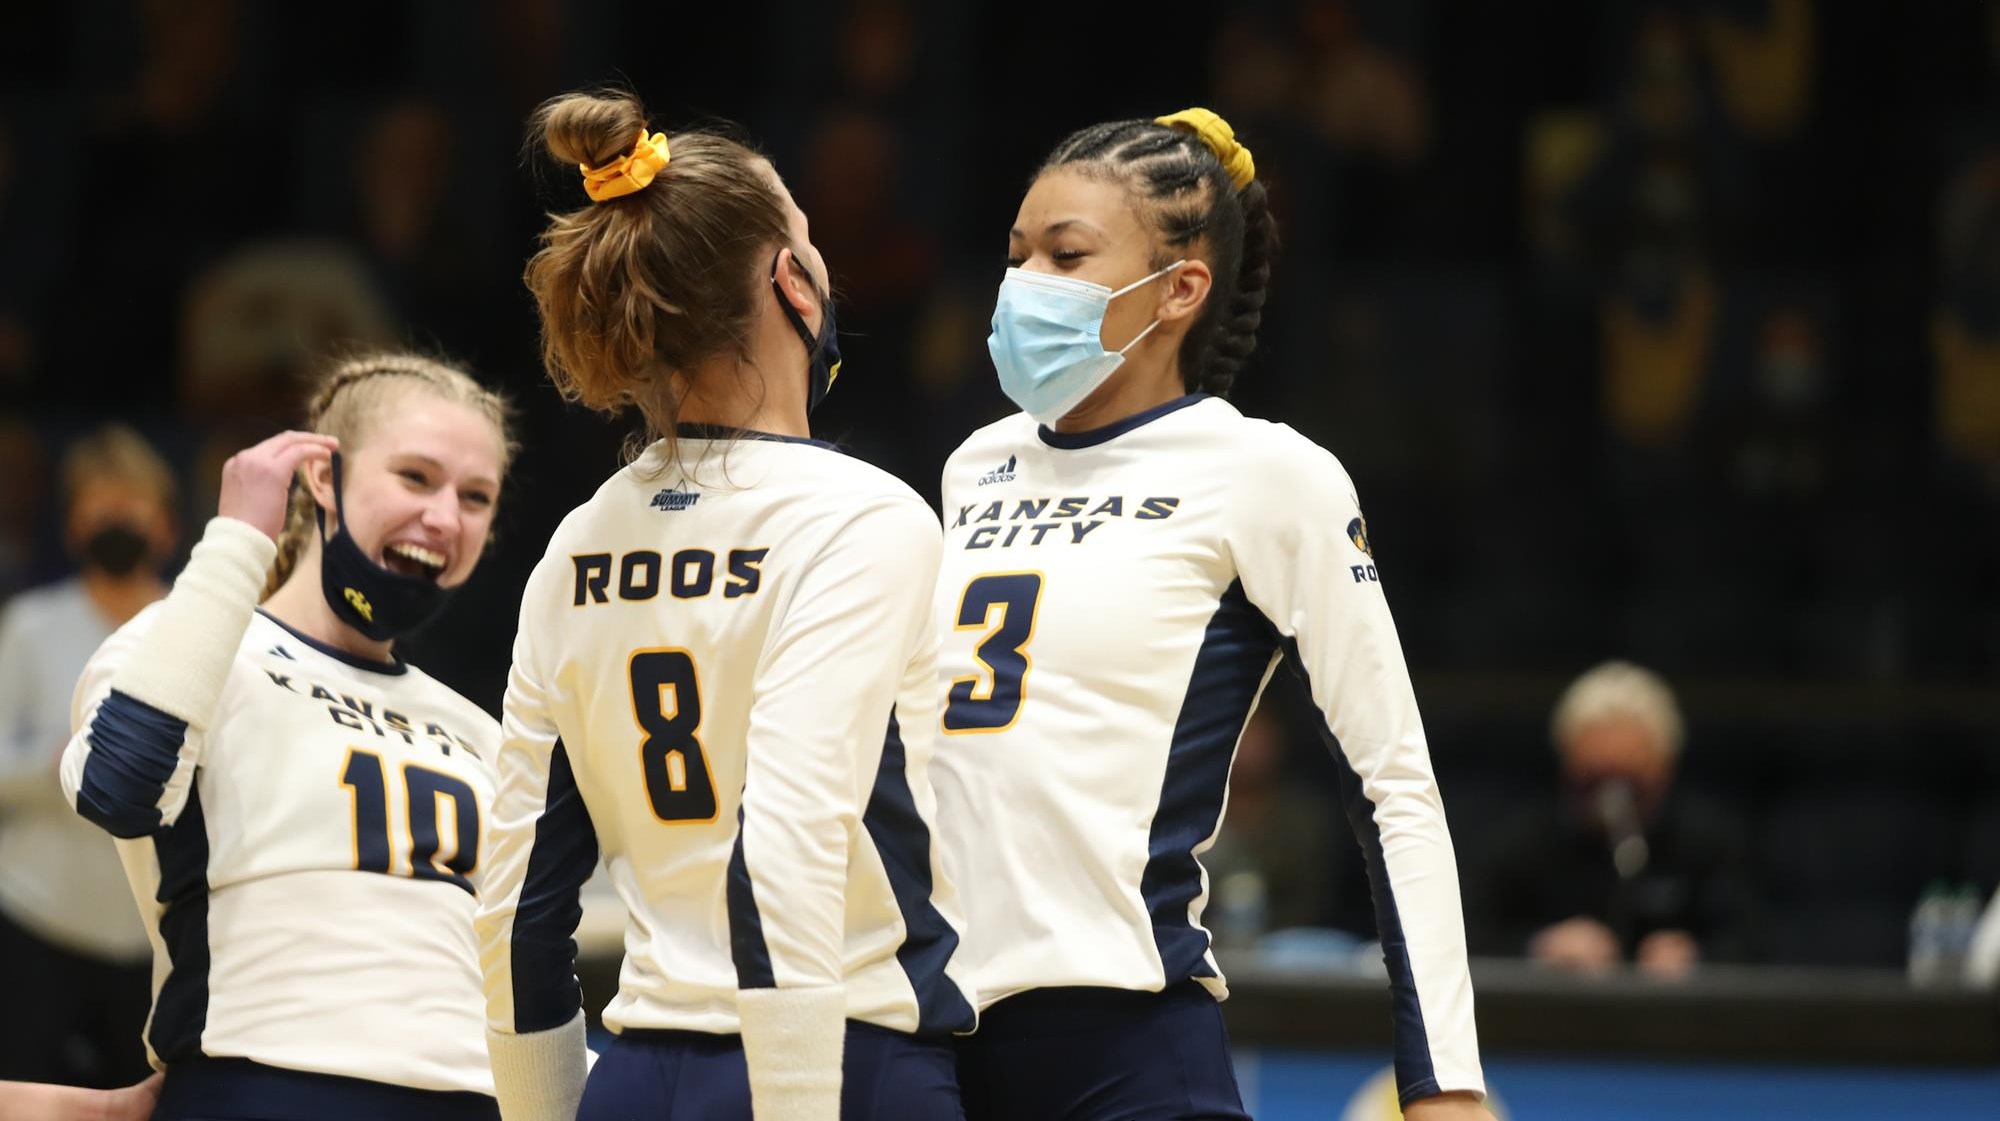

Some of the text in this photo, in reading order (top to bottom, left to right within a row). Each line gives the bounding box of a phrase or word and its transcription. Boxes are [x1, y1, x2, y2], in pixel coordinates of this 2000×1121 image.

[650, 493, 700, 507] SUMMIT
[951, 496, 1180, 529] KANSAS
[965, 520, 1105, 550] CITY
[570, 547, 770, 606] ROOS
[941, 570, 1045, 735] 3
[627, 646, 720, 826] 8
[338, 744, 481, 896] 10
